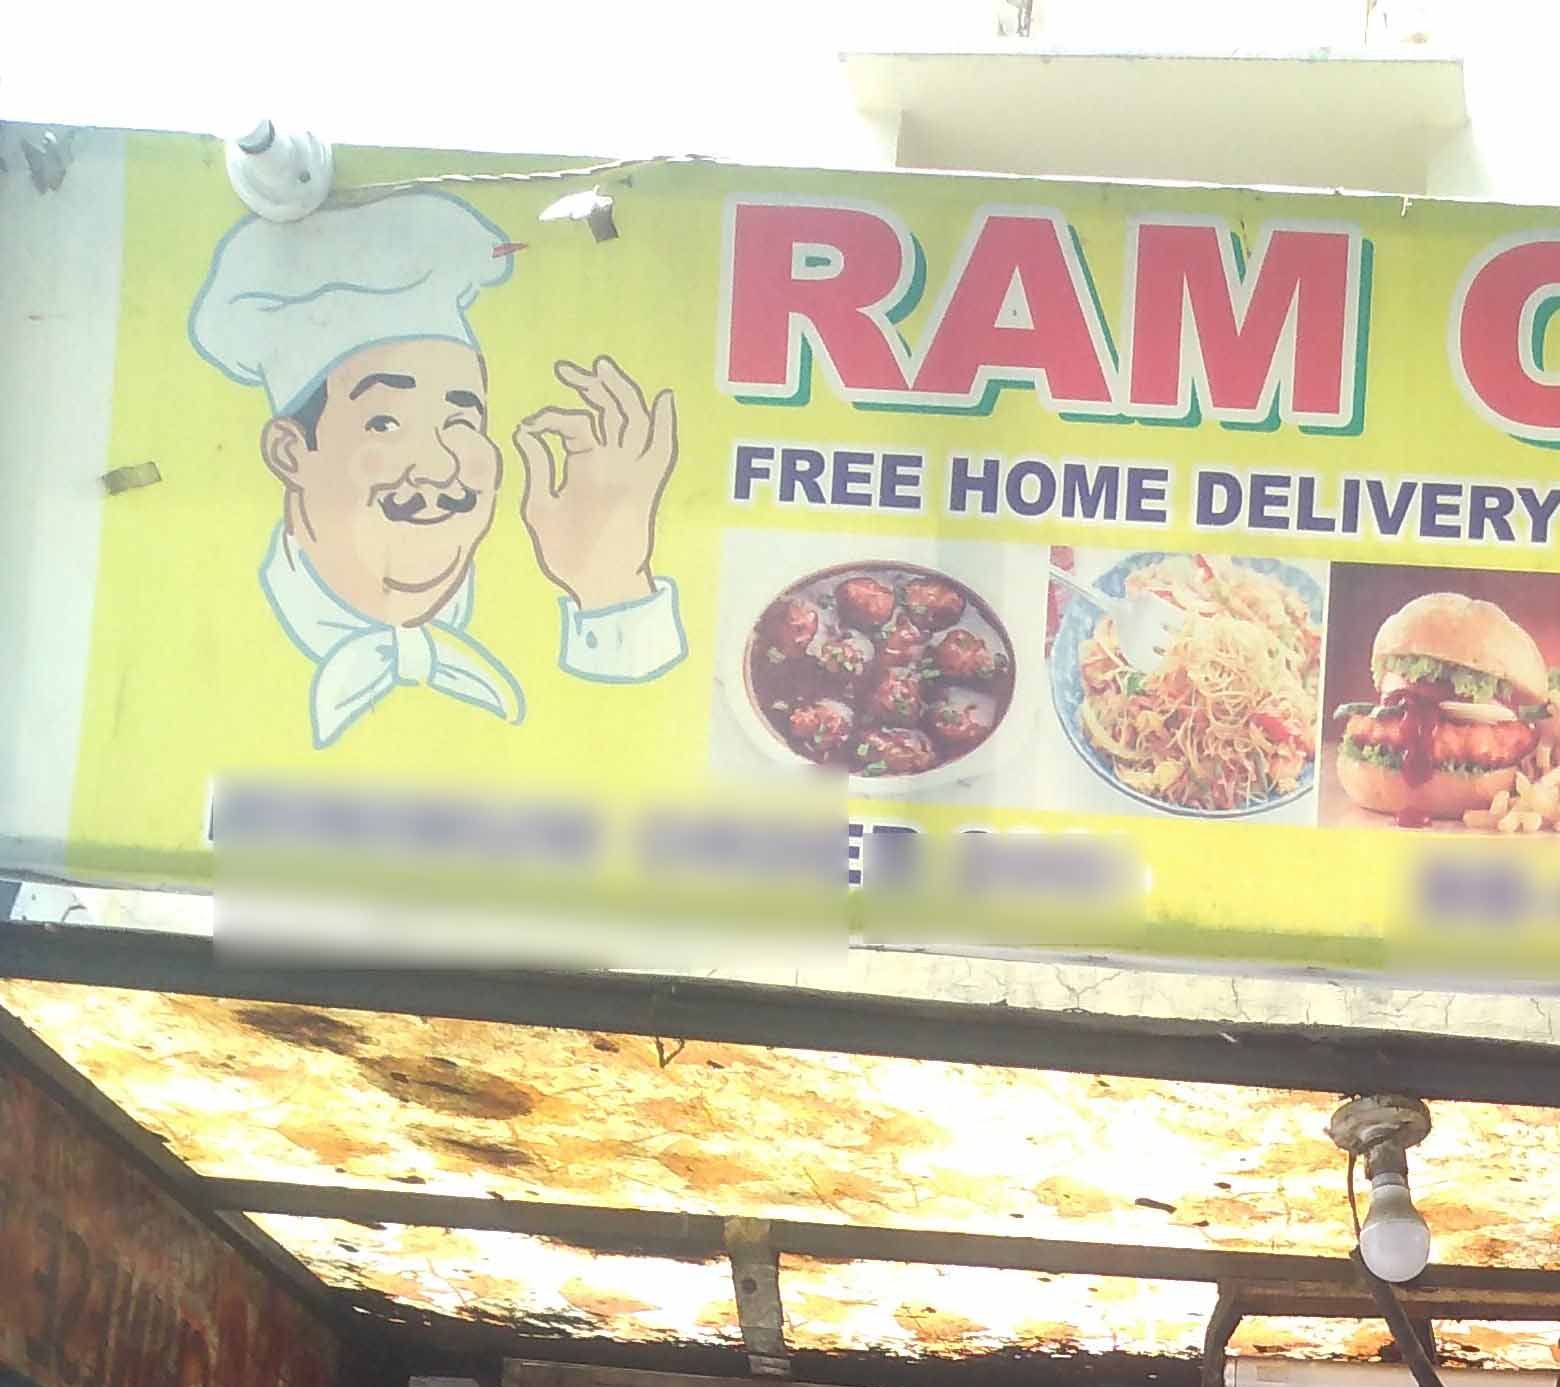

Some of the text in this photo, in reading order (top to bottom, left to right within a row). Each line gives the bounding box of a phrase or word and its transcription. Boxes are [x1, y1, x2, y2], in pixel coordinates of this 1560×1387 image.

[727, 203, 1368, 432] RAM
[734, 445, 923, 510] FREE
[949, 456, 1168, 524] HOME
